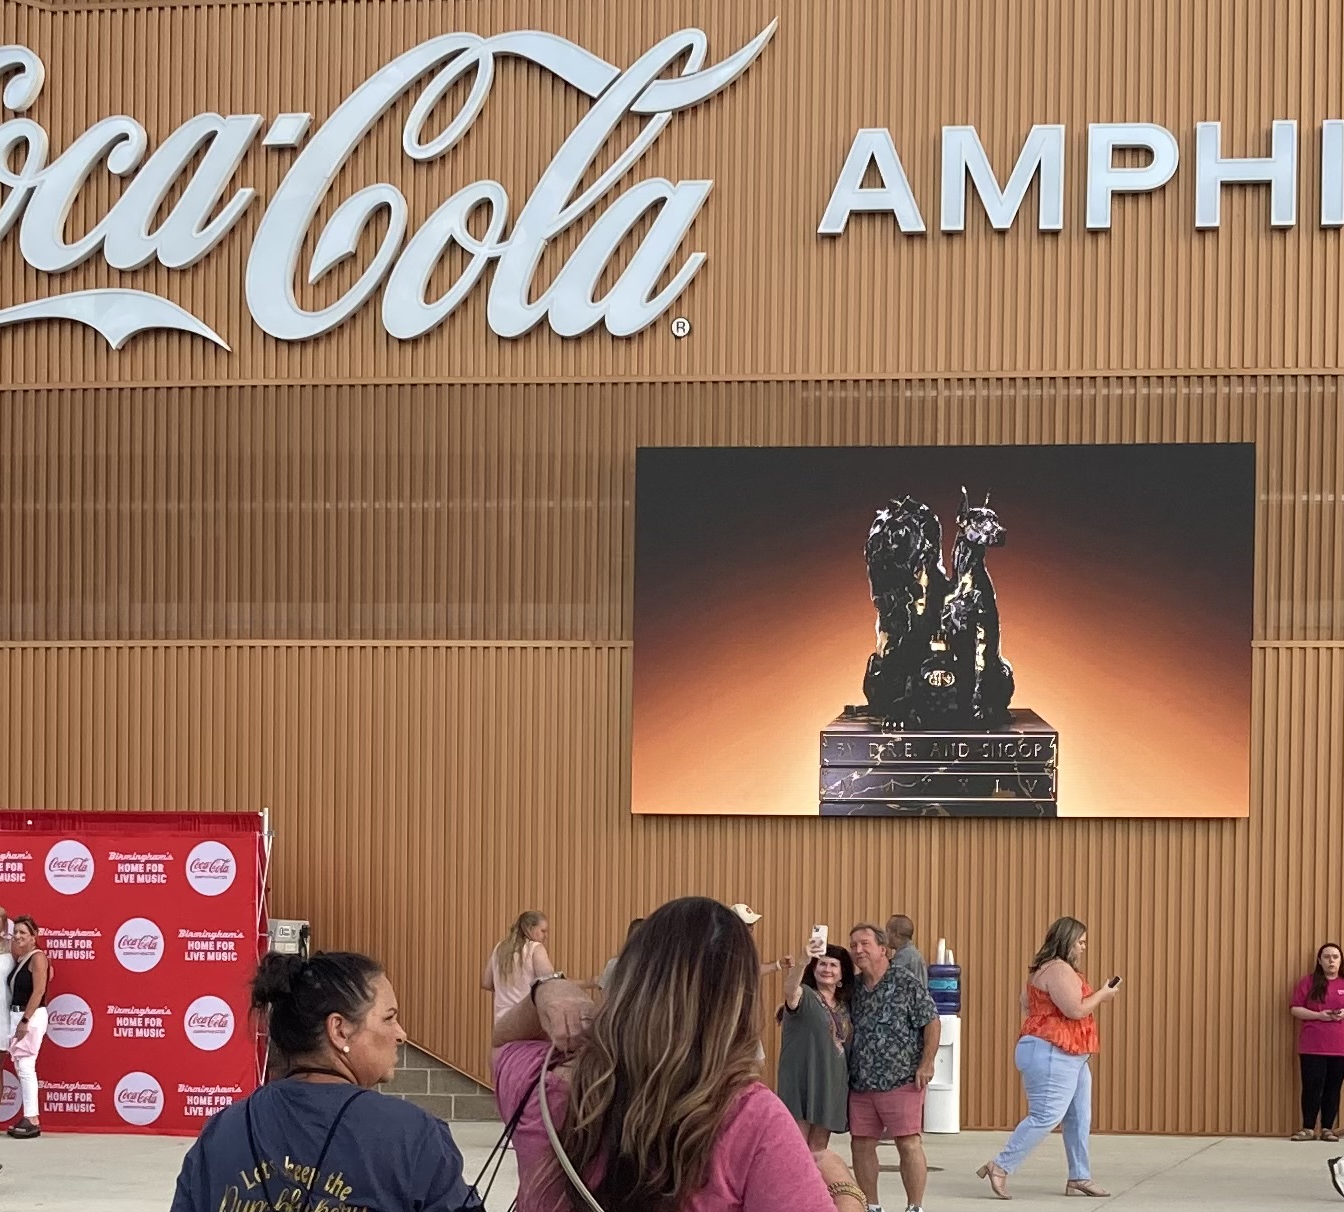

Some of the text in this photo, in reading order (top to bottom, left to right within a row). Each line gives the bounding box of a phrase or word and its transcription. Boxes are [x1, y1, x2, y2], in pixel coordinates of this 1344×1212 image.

[929, 742, 970, 758] AND
[982, 742, 1043, 758] SNOOP
[108, 851, 174, 862] Birmingham's
[5, 862, 23, 871] FOR
[118, 863, 164, 873] HOME FOR
[114, 874, 167, 884] LIVE MUSIC
[38, 927, 102, 939] Birmingham's
[177, 929, 244, 940] Birmingham's
[46, 939, 93, 949] HOME FOR
[188, 941, 235, 951] HOME FOR
[65, 950, 96, 960] MUSIC
[185, 951, 237, 961] LIVE MUSIC
[107, 1005, 172, 1017] Birmingham's
[116, 1017, 163, 1028] HOME FOR
[113, 1028, 166, 1038] LIVE MUSIC
[38, 1080, 102, 1091] Birmingham's
[177, 1083, 243, 1095] Birmingham's
[47, 1092, 93, 1102] HOME FOR
[186, 1095, 233, 1106] HOME FOR
[44, 1103, 96, 1112] LIVE MUSIC
[184, 1106, 204, 1116] LIVE
[323, 1172, 353, 1201] the
